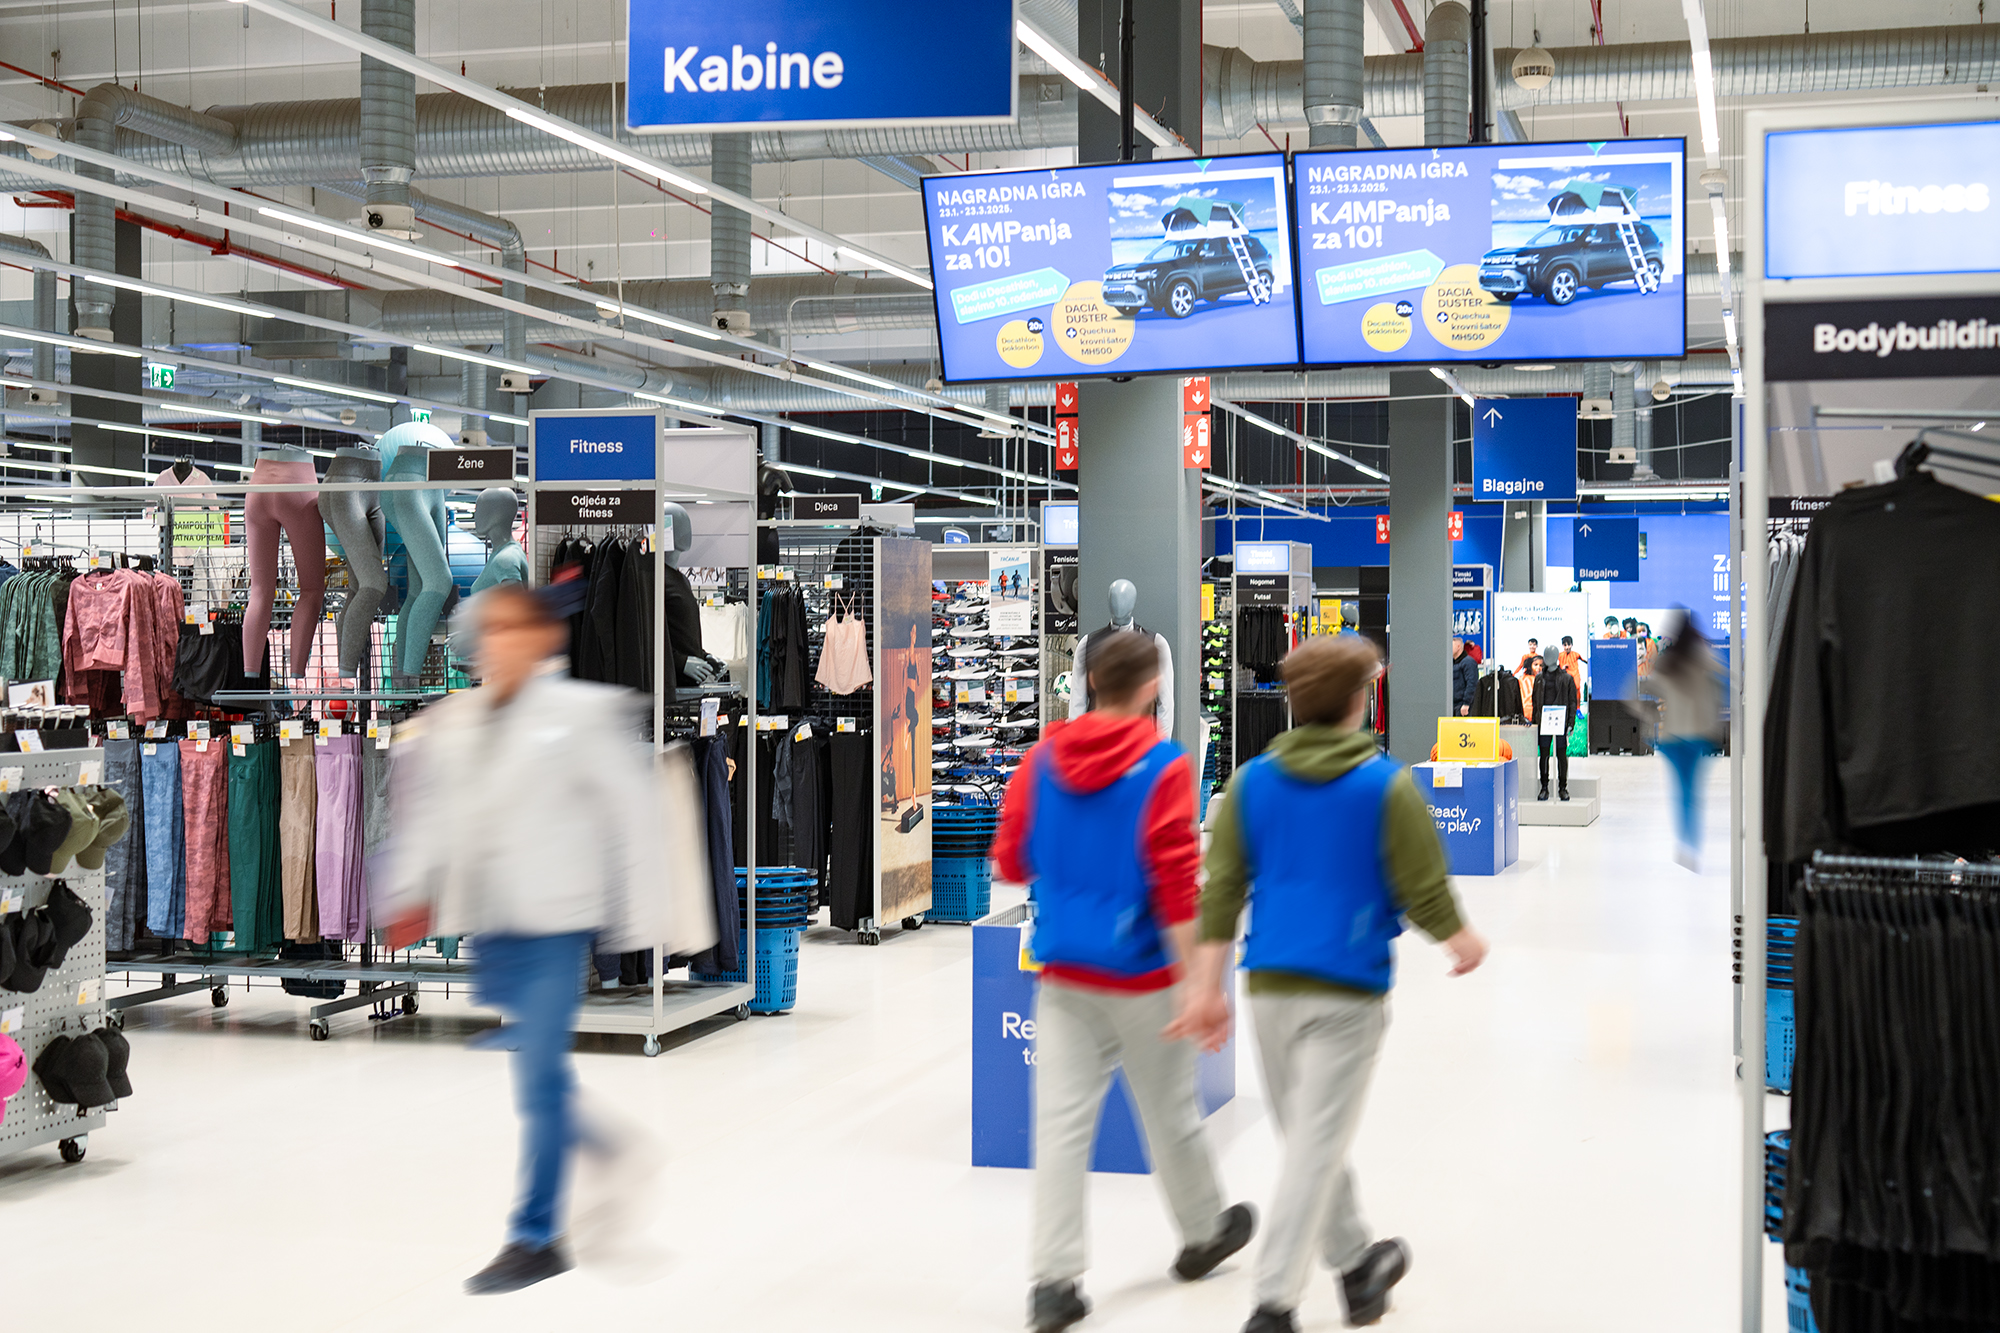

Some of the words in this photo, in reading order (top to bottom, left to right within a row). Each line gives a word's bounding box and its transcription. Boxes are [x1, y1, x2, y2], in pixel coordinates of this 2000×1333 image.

[664, 42, 844, 92] Kabine
[1308, 164, 1417, 183] NAGRADNA
[1421, 162, 1468, 178] IGRA
[937, 185, 1038, 206] NAGRADNA
[1041, 182, 1086, 199] IGRA
[1310, 185, 1330, 194] 23.1.
[1337, 183, 1388, 194] 23.3.2025.
[1845, 180, 1990, 216] Fitness
[939, 208, 959, 217] 23.1.
[965, 204, 1012, 216] 23.3.2025.
[1311, 198, 1450, 227] KAMPanja
[942, 218, 1072, 247] KAMPanja
[1312, 232, 1342, 249] za
[1344, 225, 1382, 248] 10!
[945, 253, 973, 270] za
[975, 245, 1011, 269] 10!
[1354, 260, 1411, 278] Decathlon,
[986, 279, 1038, 296] Decathlon,
[1324, 284, 1363, 297] slavimo
[1363, 278, 1378, 289] 10.
[1438, 288, 1473, 297] DACIA
[960, 302, 995, 316] slavimo
[995, 297, 1009, 307] 10.
[1066, 304, 1098, 313] DACIA
[1397, 304, 1412, 314] 20x
[1438, 298, 1482, 308] DUSTER
[1066, 314, 1108, 323] DUSTER
[1451, 312, 1490, 321] Quechua
[1029, 322, 1043, 330] 20x
[1079, 328, 1116, 336] Quechua
[1480, 322, 1501, 330] šator
[1814, 318, 2000, 357] Bodybuildin
[1082, 347, 1112, 355] MH500
[570, 439, 623, 453] Fitness
[458, 455, 484, 468] Žene
[1483, 478, 1544, 494] Blagajne
[572, 495, 606, 507] Odjeća
[608, 497, 620, 505] za
[814, 502, 838, 512] Djeca
[579, 508, 613, 518] fitness
[1580, 568, 1618, 578] Blagajne
[1426, 805, 1467, 820] Ready
[1436, 820, 1445, 829] to
[1448, 818, 1481, 834] play?
[1003, 1012, 1037, 1040] Re
